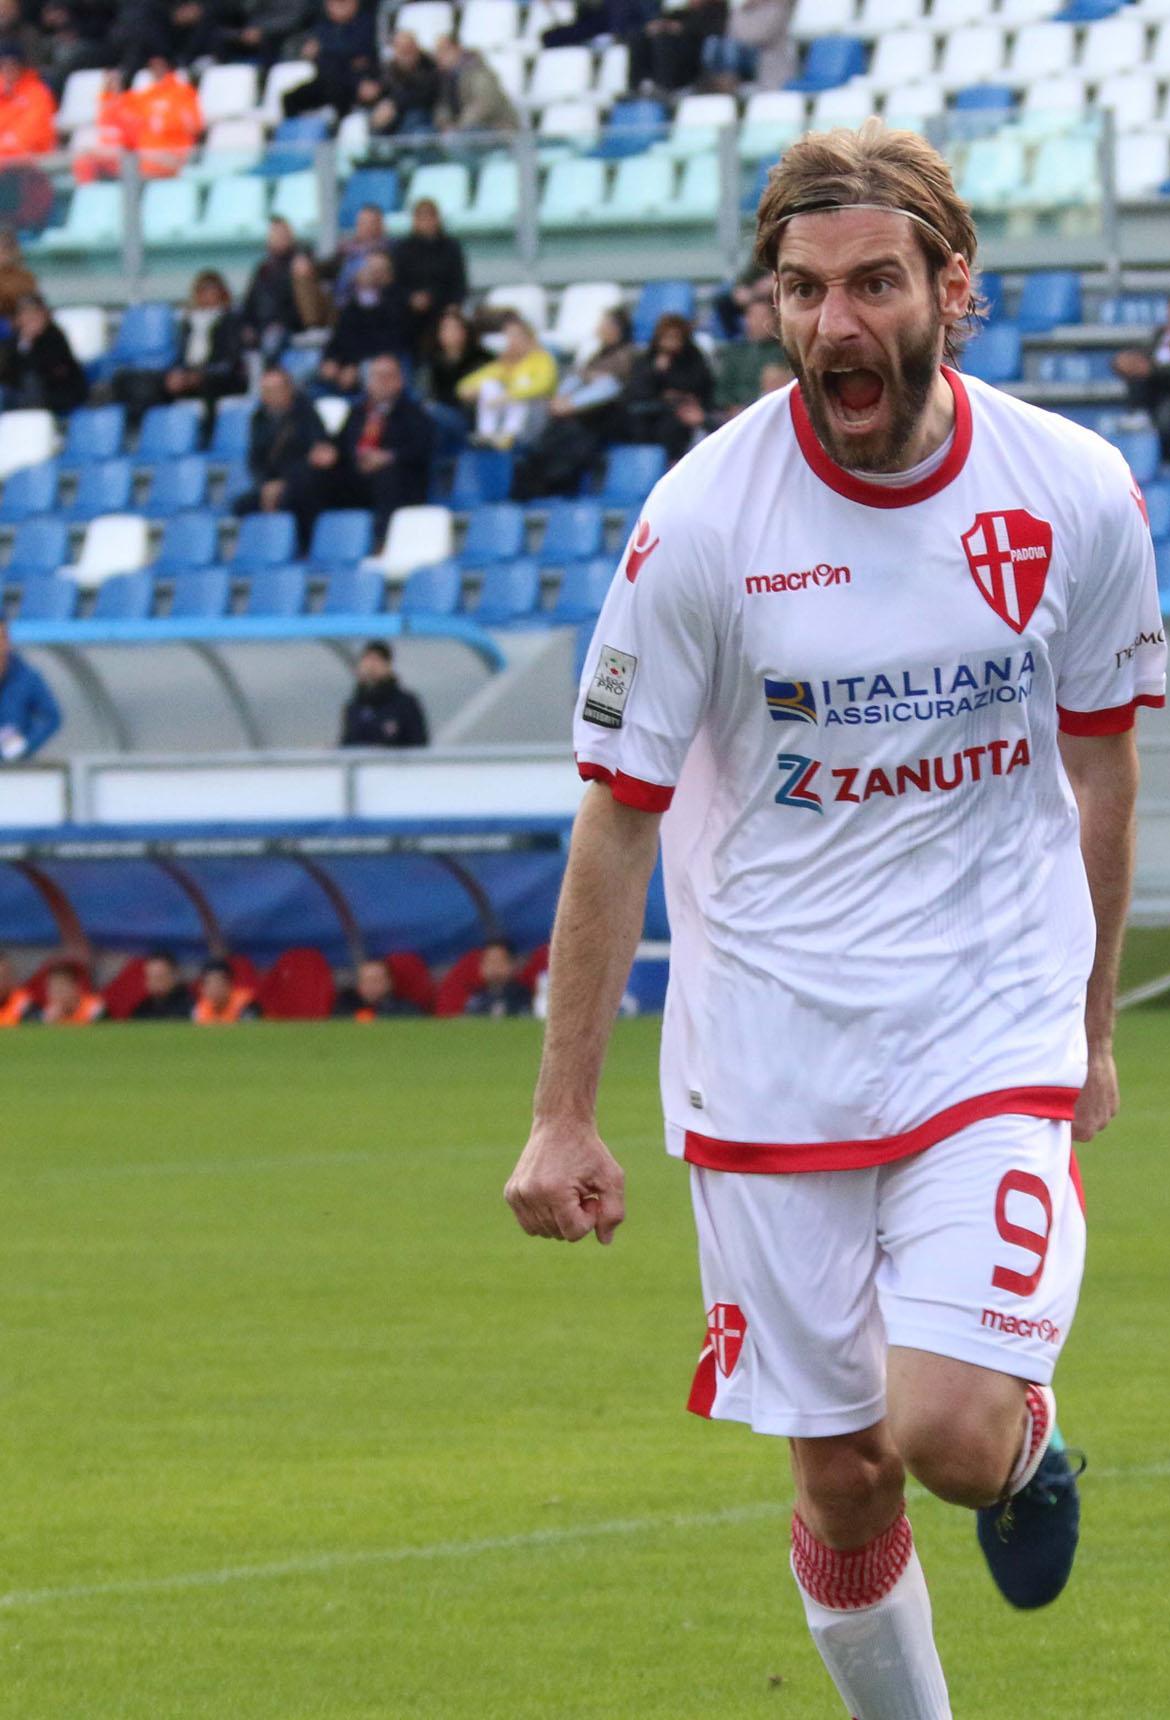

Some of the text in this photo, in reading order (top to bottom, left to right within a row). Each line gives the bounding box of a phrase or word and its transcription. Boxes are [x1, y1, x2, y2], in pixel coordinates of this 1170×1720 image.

[1010, 546, 1048, 562] PADOVA
[745, 564, 851, 594] macron
[597, 680, 624, 695] PRO
[821, 651, 1035, 705] ITALIANA
[831, 738, 1031, 803] ZANUTTA
[991, 1168, 1053, 1298] 9
